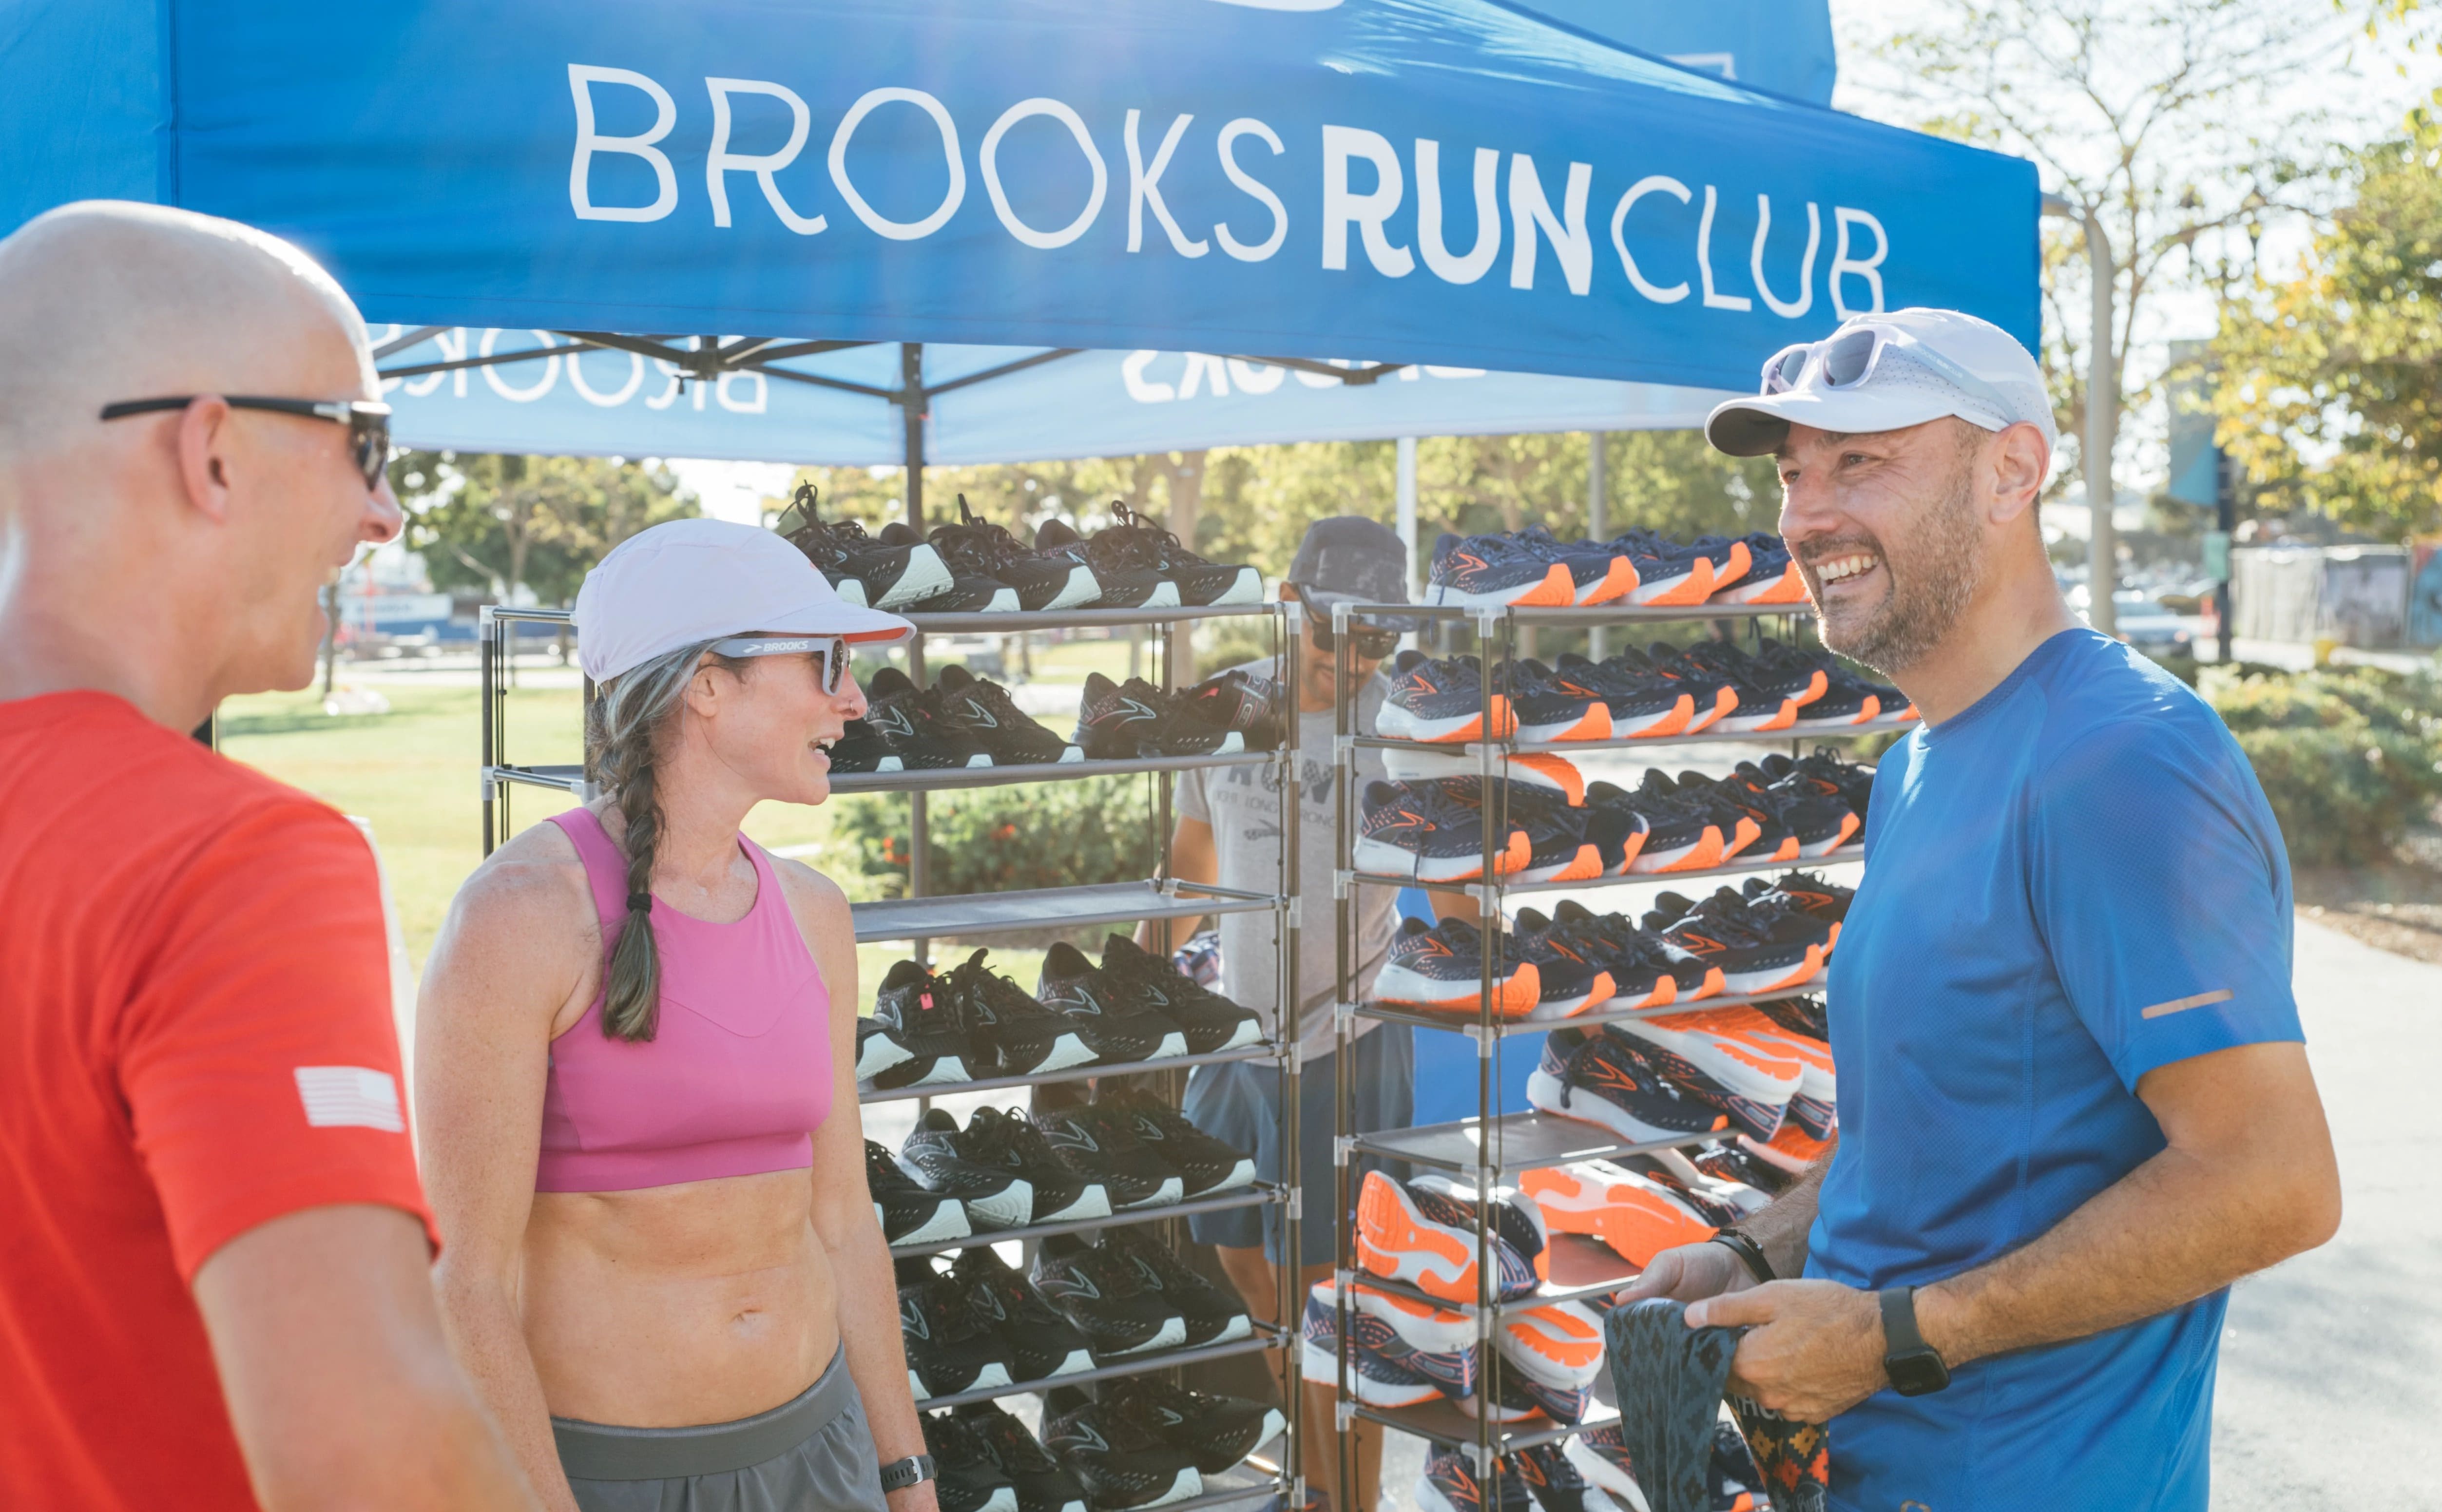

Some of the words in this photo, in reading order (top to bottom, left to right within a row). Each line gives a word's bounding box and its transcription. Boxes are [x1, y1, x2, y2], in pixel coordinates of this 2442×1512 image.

[568, 64, 1289, 263] BROOKS
[1322, 124, 1593, 295] RUN
[1611, 175, 1887, 322] CLUB
[764, 641, 809, 652] BROOKS
